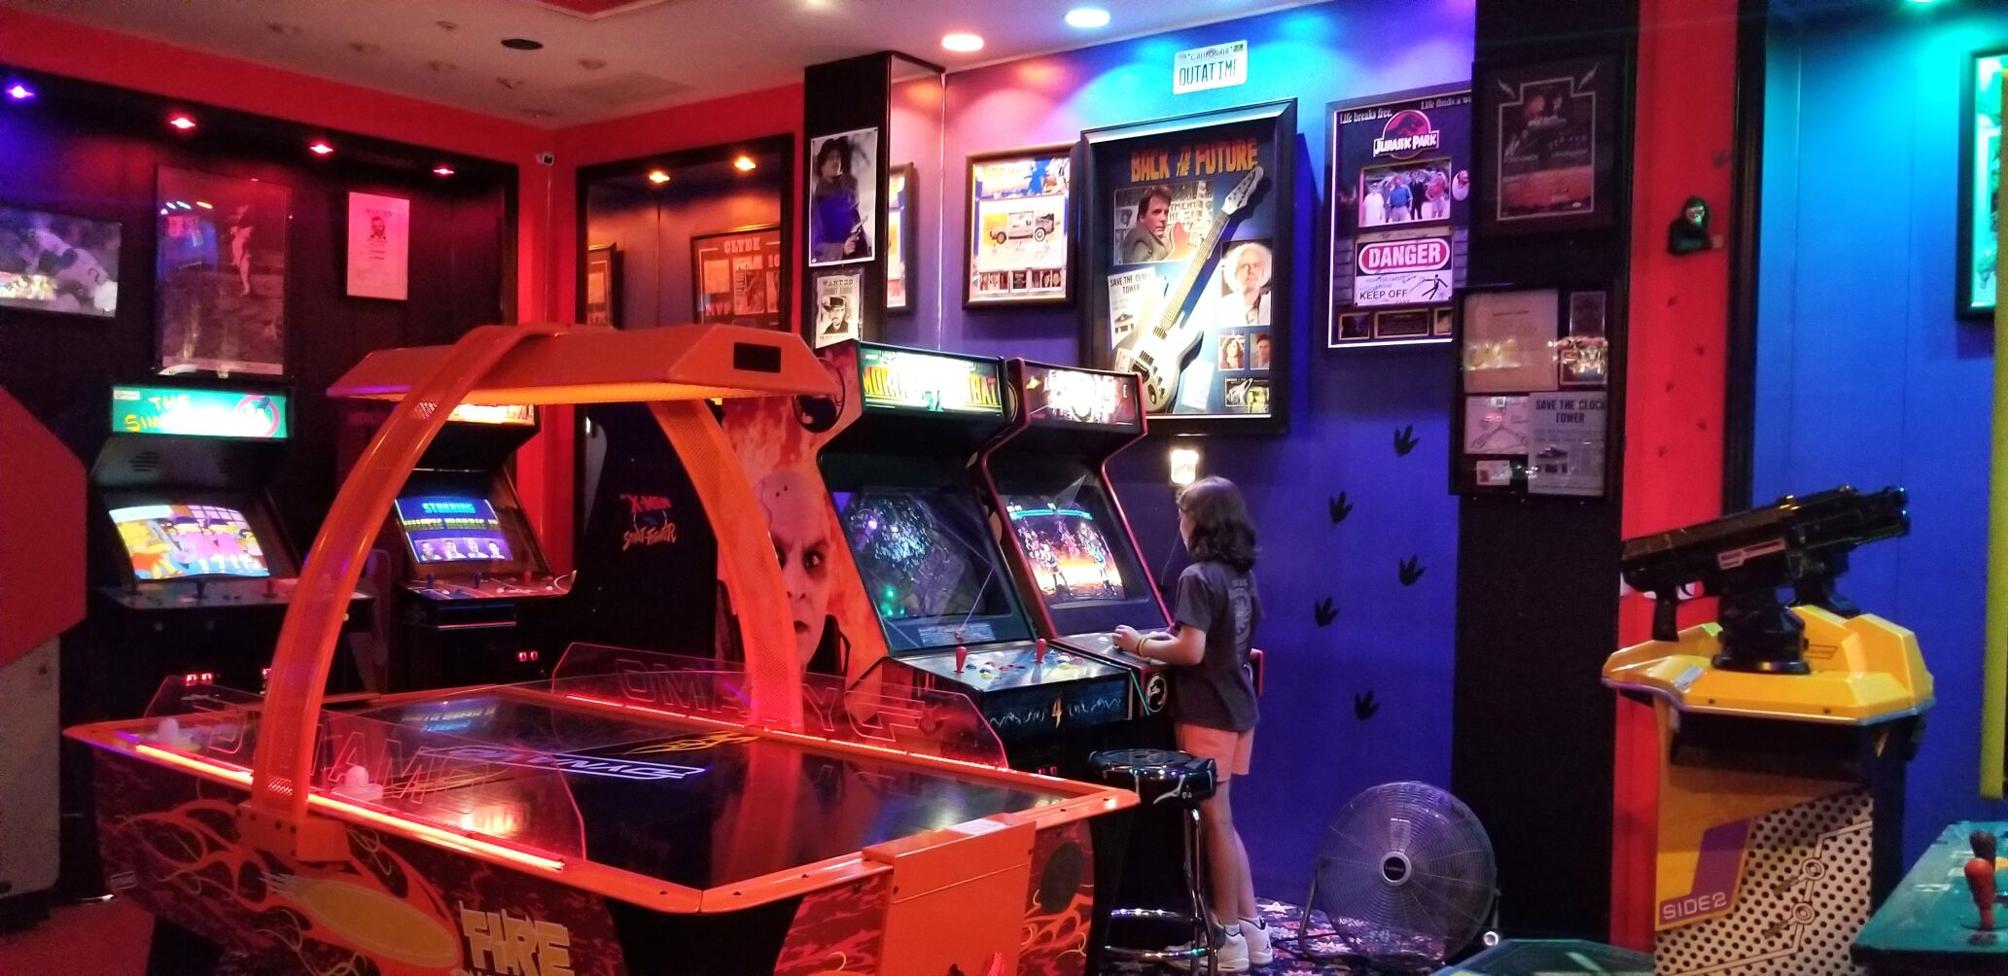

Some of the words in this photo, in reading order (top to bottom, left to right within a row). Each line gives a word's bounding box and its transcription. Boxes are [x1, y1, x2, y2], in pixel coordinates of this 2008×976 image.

[1340, 112, 1352, 124] Life
[1353, 109, 1376, 122] breaks
[1375, 138, 1412, 155] JURASSIC
[1412, 134, 1437, 149] PARK
[1196, 139, 1258, 175] FUTURE
[1131, 150, 1170, 182] BACK
[724, 237, 760, 253] CLYDE
[1368, 242, 1441, 268] DANGER
[823, 279, 853, 287] WANTED
[1110, 277, 1122, 288] SAVE
[1123, 275, 1133, 284] THE
[1122, 284, 1140, 294] TOWER
[1360, 290, 1386, 300] KEEP
[1388, 289, 1408, 298] OFF
[1535, 400, 1555, 410] SAVE
[1560, 399, 1575, 410] THE
[1578, 399, 1605, 410] CLOCK
[1555, 412, 1585, 423] TOWER
[459, 900, 576, 976] FIRE
